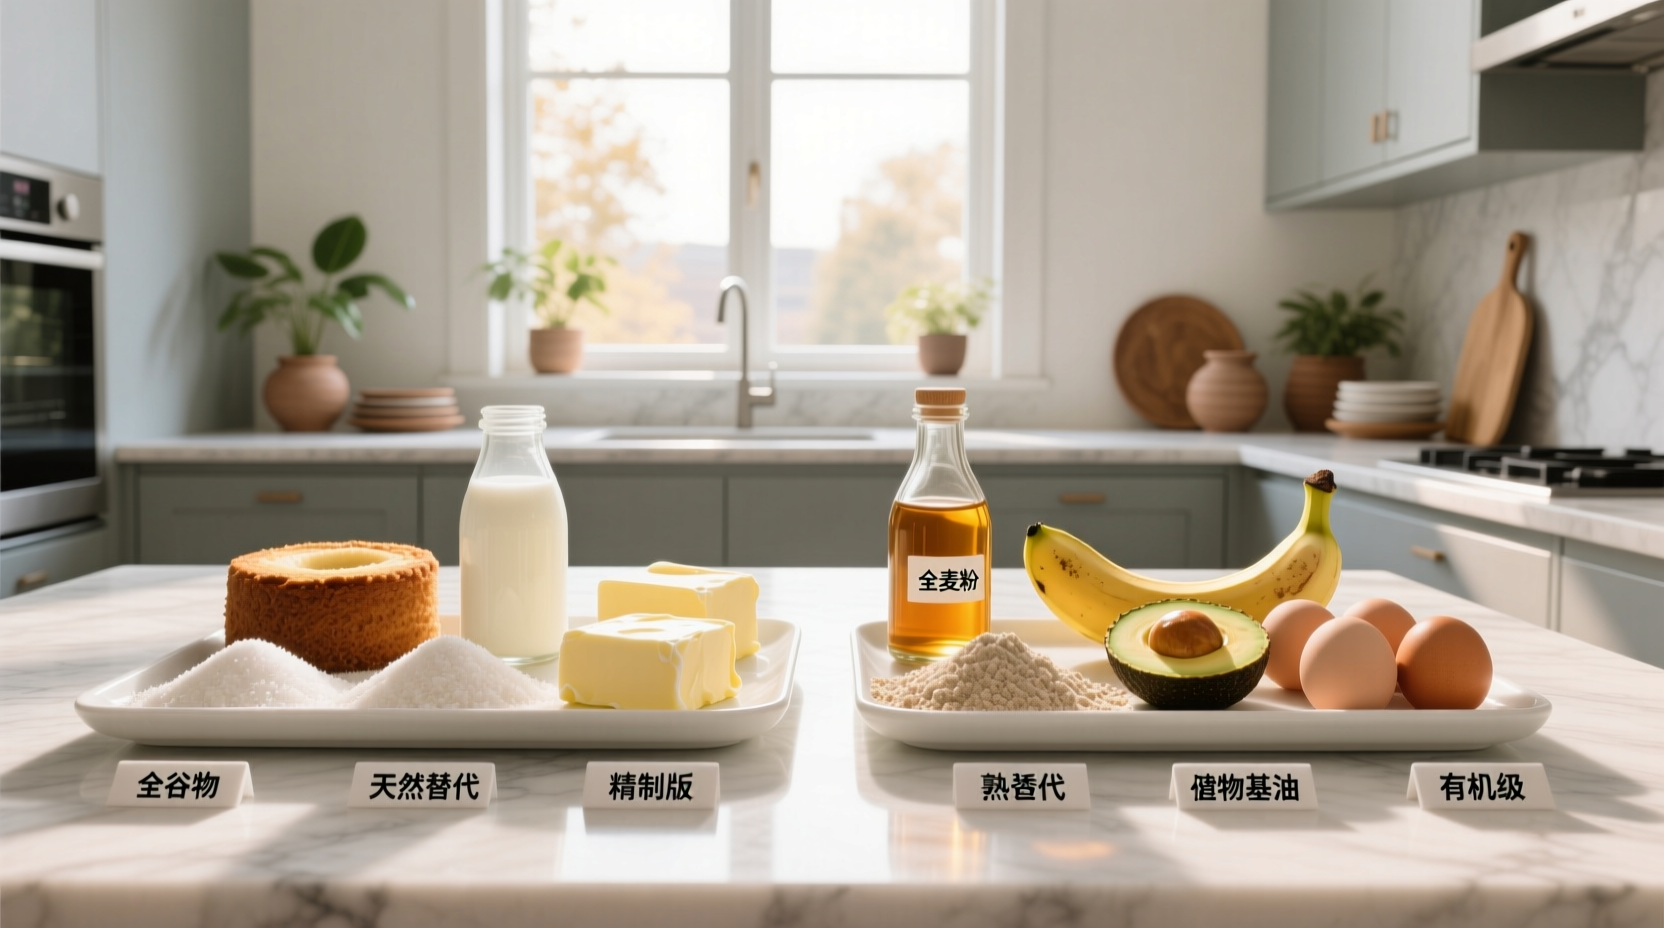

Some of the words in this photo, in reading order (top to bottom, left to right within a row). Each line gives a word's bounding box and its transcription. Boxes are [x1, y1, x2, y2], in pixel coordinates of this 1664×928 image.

[918, 568, 979, 592] 全麦粉
[136, 770, 221, 800] 全谷物
[368, 771, 480, 801] 天然替代
[608, 771, 693, 801] 精制版
[1439, 771, 1525, 802] 有机级
